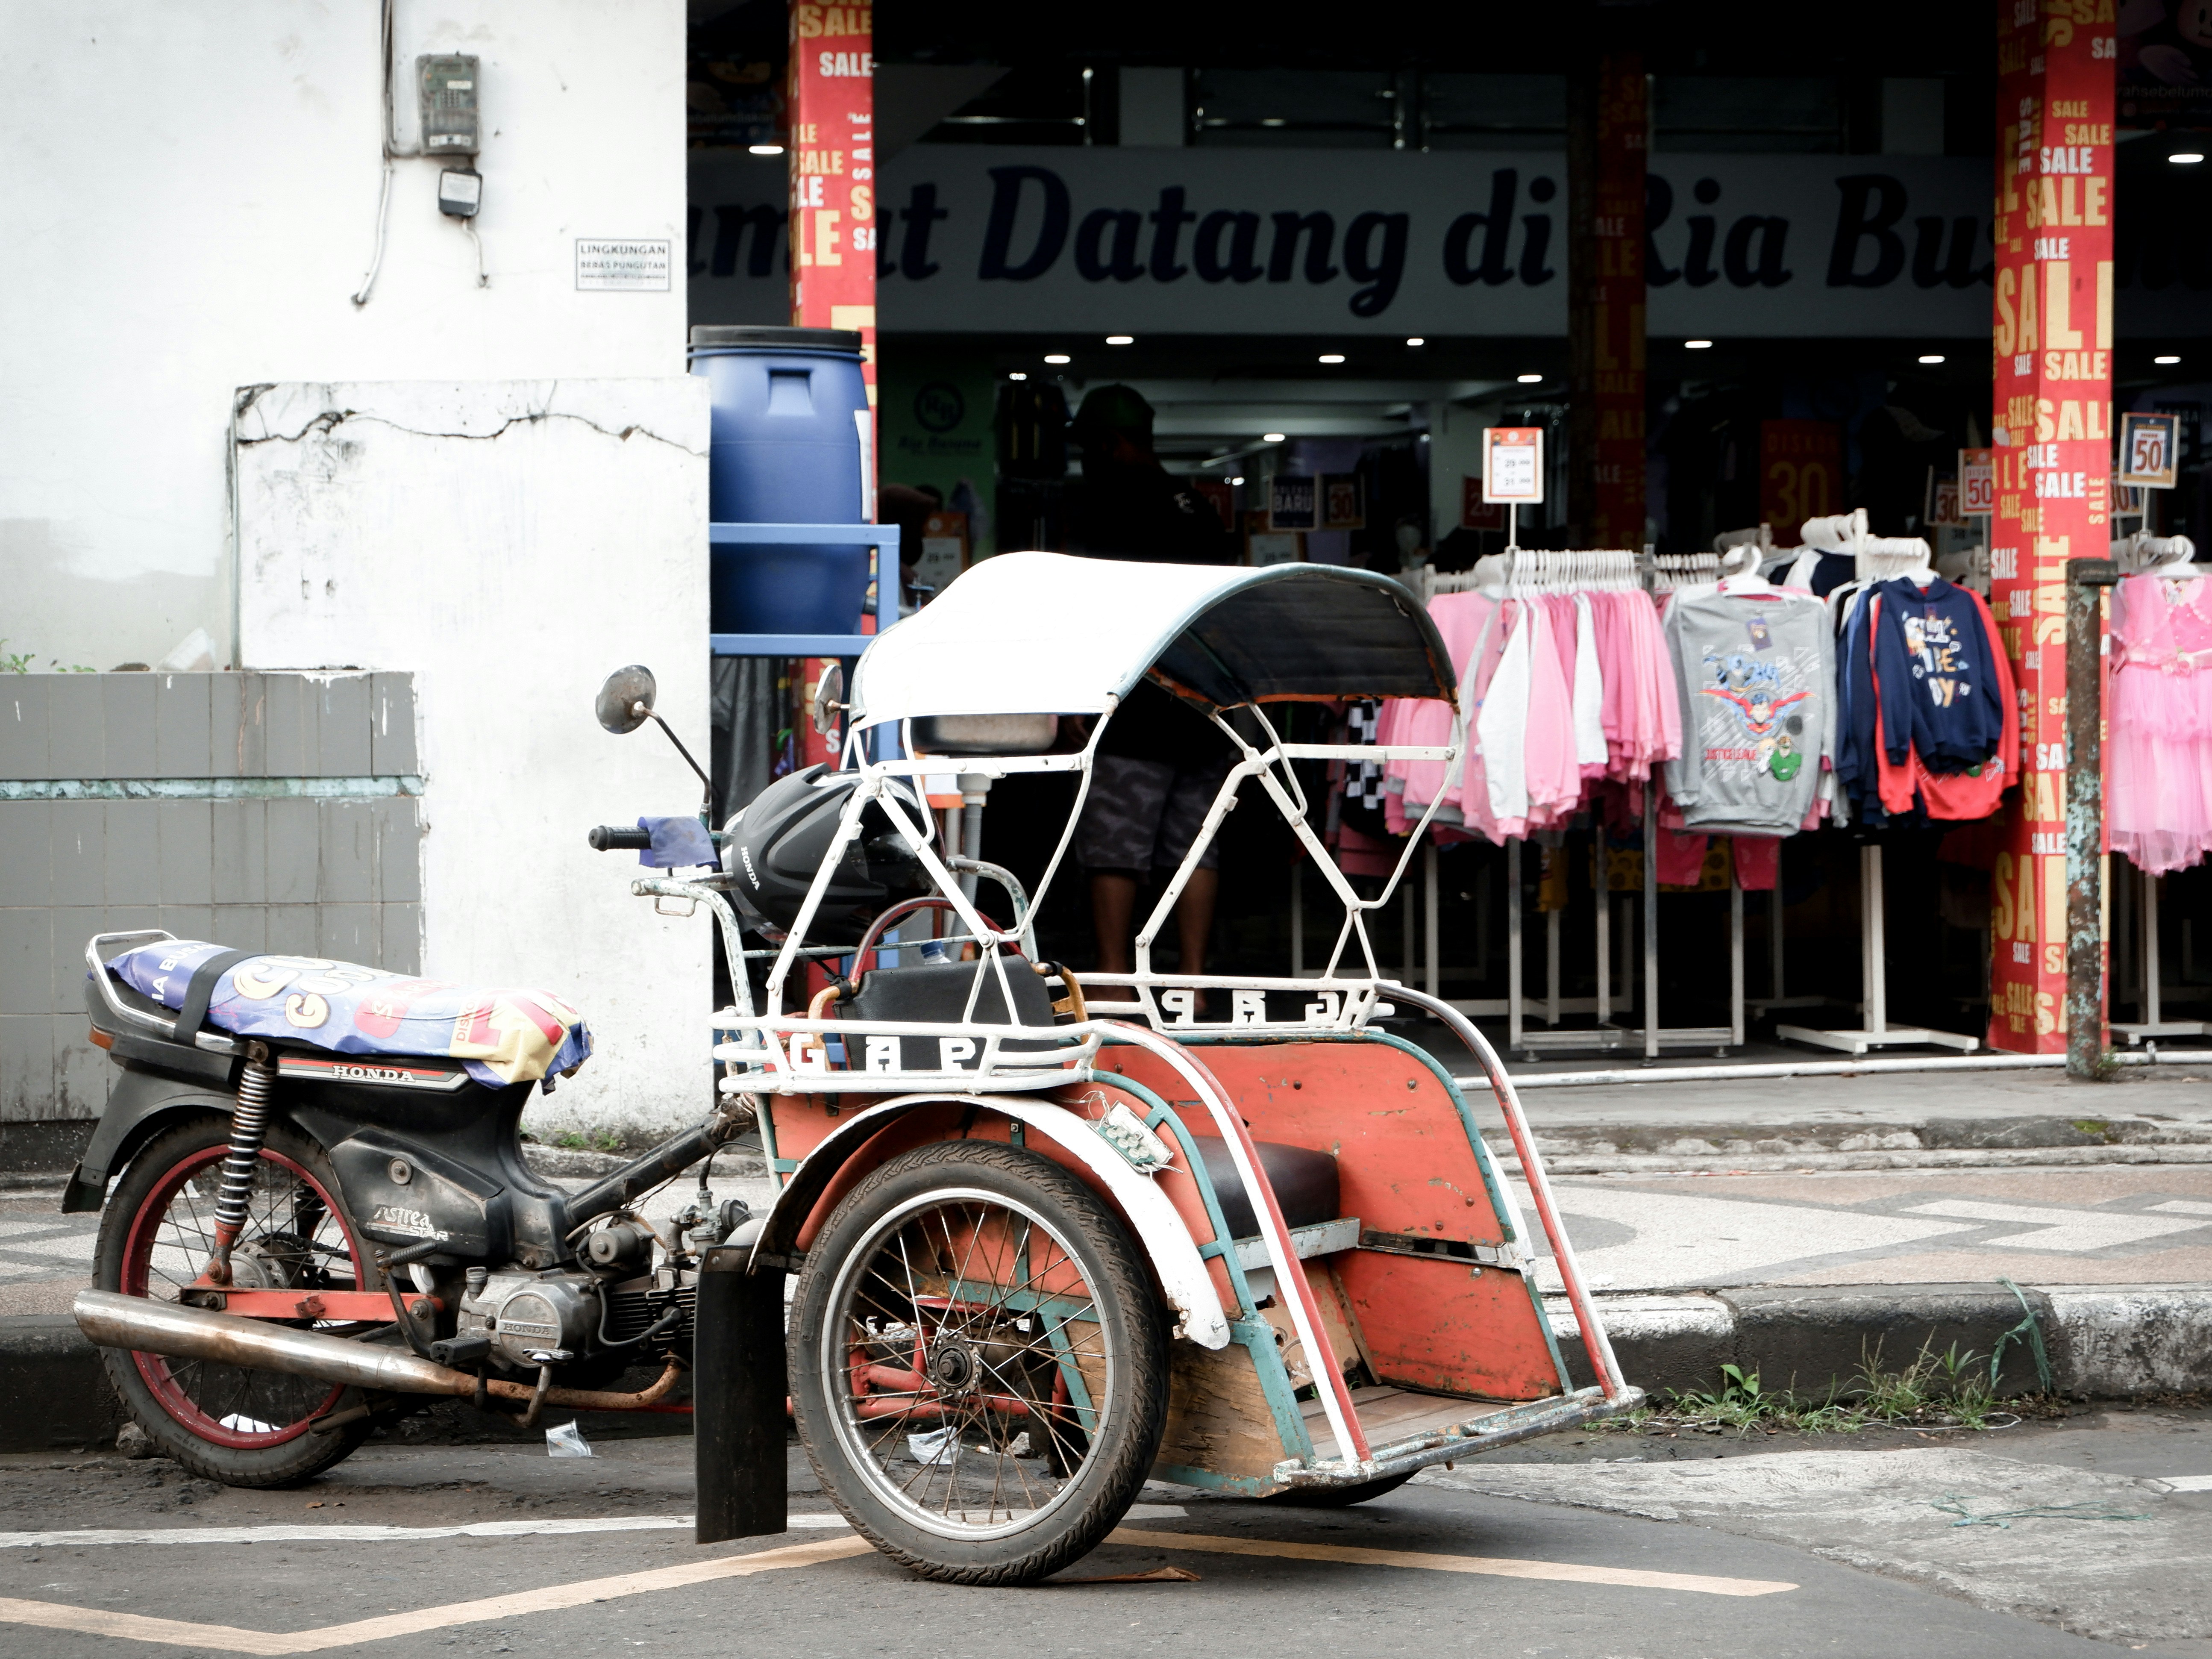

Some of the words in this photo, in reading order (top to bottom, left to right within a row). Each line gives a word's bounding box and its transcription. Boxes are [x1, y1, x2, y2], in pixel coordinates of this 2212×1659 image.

[799, 5, 872, 38] SALE
[819, 51, 873, 77] SALE
[2052, 100, 2089, 118] SALE
[848, 113, 872, 180] SALE
[2065, 123, 2111, 146] SALE
[2040, 146, 2093, 174] SALE
[2026, 176, 2107, 229] SALE
[581, 244, 665, 255] LINGKUNGAN
[977, 165, 1409, 317] Datang
[1443, 169, 1557, 287] di
[2034, 238, 2069, 260] SALE
[581, 261, 611, 269] BEBAS
[613, 261, 665, 270] PUNGUTAN
[2045, 351, 2106, 381] SALE
[2027, 444, 2059, 469] SALE
[2134, 440, 2162, 473] 50
[1765, 460, 1829, 529] 30
[1968, 479, 1992, 504] 50
[2035, 472, 2086, 498] SALE
[2089, 477, 2104, 525] SALE
[1991, 548, 2018, 579] SALE
[2009, 590, 2031, 618] SALE
[740, 846, 761, 891] HONDA
[2013, 941, 2030, 965] SALE
[790, 1032, 976, 1073] GAP
[332, 1065, 415, 1082] HONDA
[503, 1323, 549, 1335] HONDA
